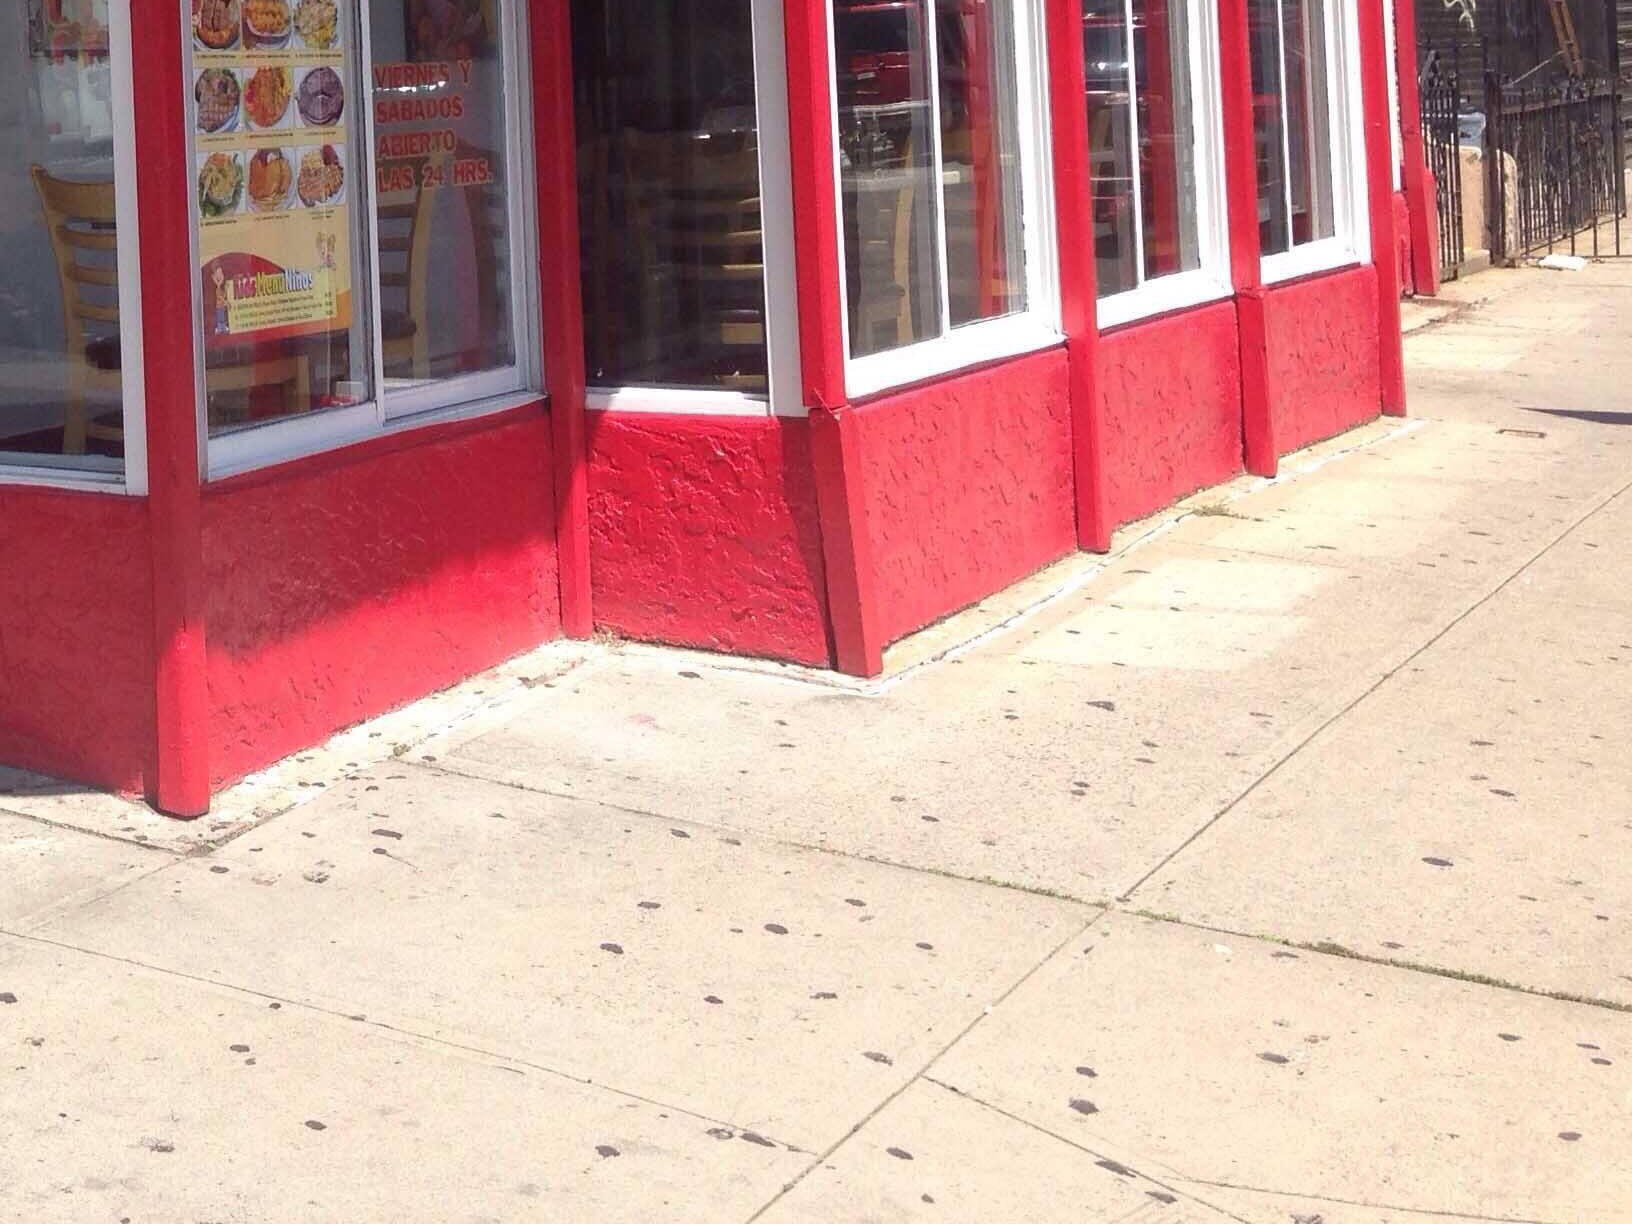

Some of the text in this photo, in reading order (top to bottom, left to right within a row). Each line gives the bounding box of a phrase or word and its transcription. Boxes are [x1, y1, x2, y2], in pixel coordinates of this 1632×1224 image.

[375, 94, 464, 123] SABADOS
[377, 128, 456, 156] ABIERTO
[377, 167, 413, 192] LAS
